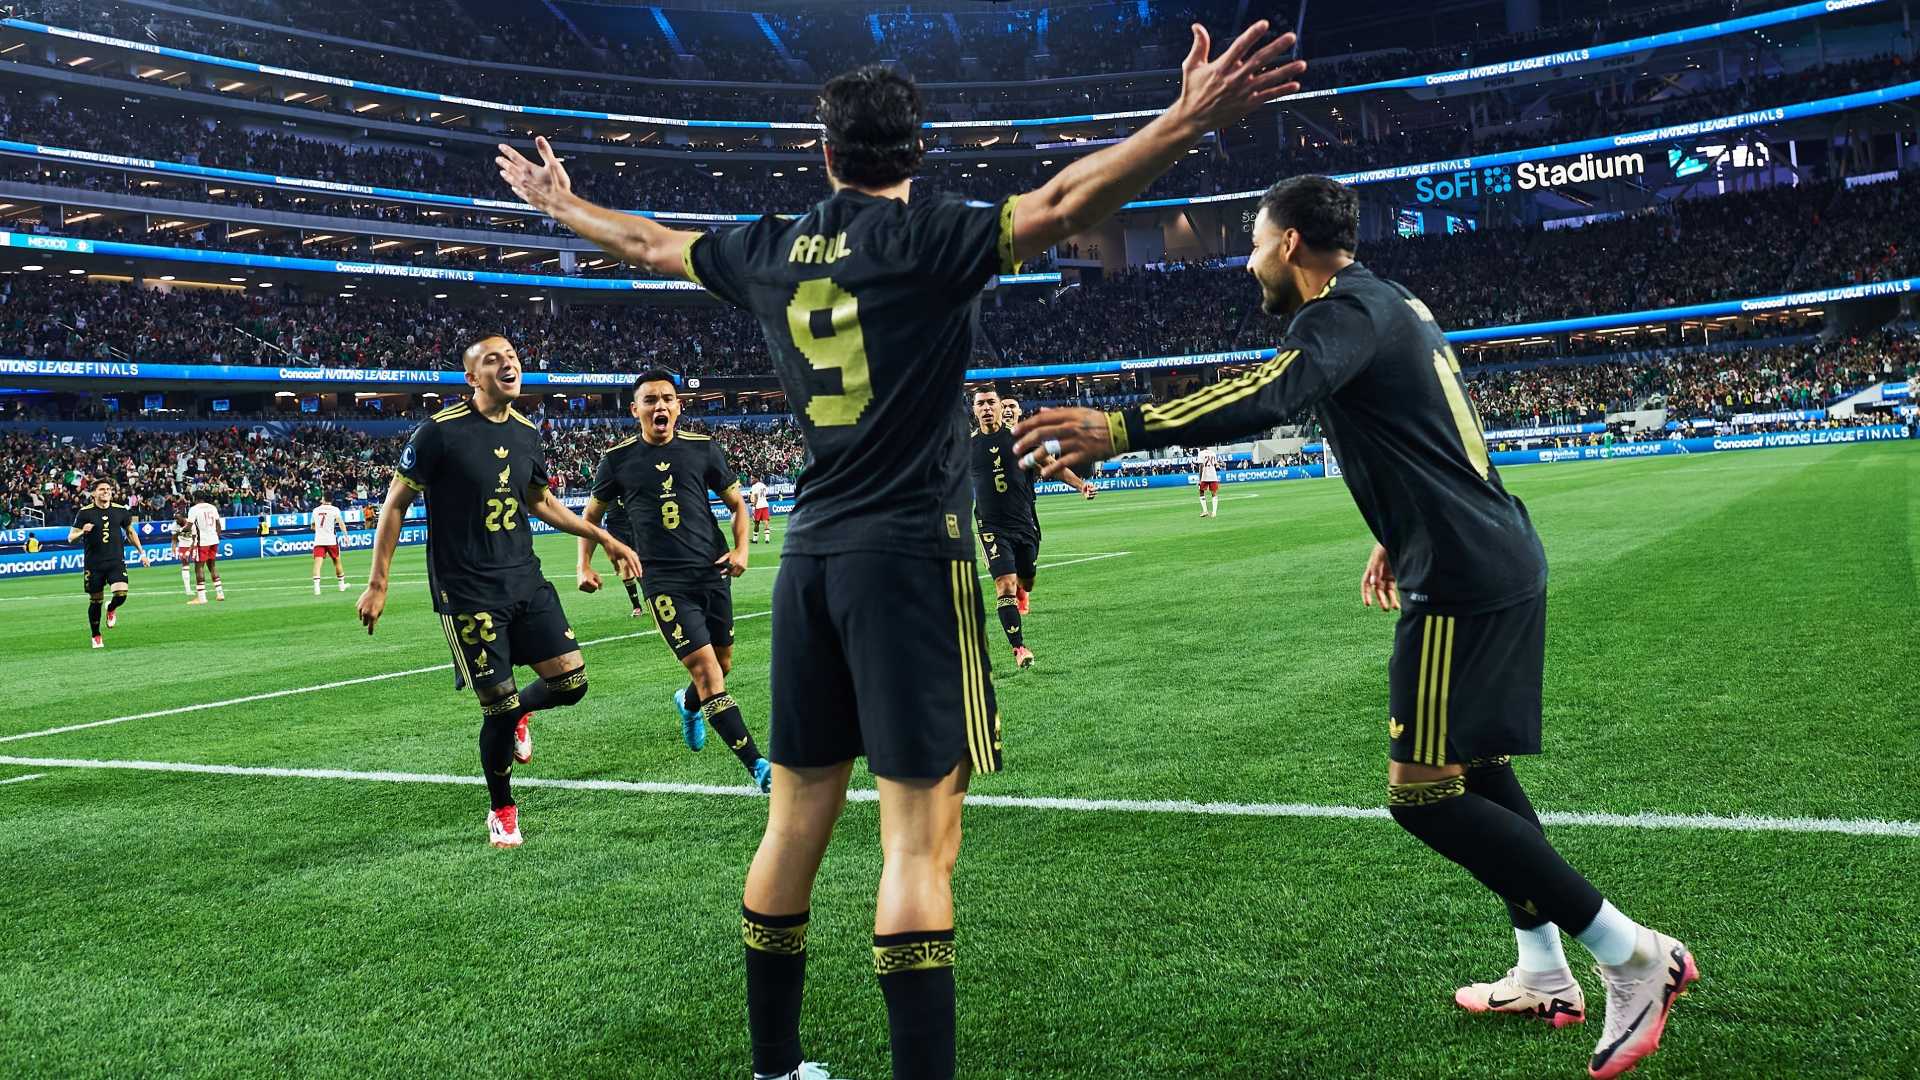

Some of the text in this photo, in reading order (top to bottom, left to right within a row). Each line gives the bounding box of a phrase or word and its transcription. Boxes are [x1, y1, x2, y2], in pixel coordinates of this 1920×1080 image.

[1426, 50, 1589, 85] Concacaf NATIONS LEAGUE FINALS
[1615, 109, 1784, 145] Concacaf NATIONS LEAGUE FINALS
[125, 157, 154, 168] FINALS
[1360, 170, 1396, 182] NATIONS
[1397, 164, 1430, 179] LEAGUE
[1431, 159, 1470, 172] FINALS
[1416, 153, 1644, 203] SoFi Stadium
[28, 237, 67, 249] MEXICO
[336, 262, 474, 281] Concacaf NATIONS LEAGUE FINALS
[632, 280, 665, 290] Concacaf
[1742, 281, 1911, 310] Concacaf NATIONS LEAGUE FINALS
[786, 277, 875, 427] 9
[1121, 351, 1262, 369] Concacaf NATIONS LEAGUE FINALS
[39, 361, 84, 374] LEAGUE
[86, 363, 138, 375] FINALS
[280, 368, 439, 382] Concacaf NATIONS LEAGUE FINALS
[548, 373, 582, 383] Concacaf
[583, 374, 614, 384] NATIONS
[1550, 424, 1582, 434] FINALS
[1714, 426, 1909, 449] Concacaf NATIONS LEAGUE FINALS
[1585, 448, 1598, 458] EN
[994, 474, 1007, 493] 6
[1110, 478, 1148, 488] FINALS
[318, 513, 327, 528] 7
[485, 497, 519, 532] 22
[661, 501, 680, 530] 8
[102, 532, 109, 543] 2
[0, 556, 57, 574] oncacaf
[655, 594, 677, 622] 8
[458, 611, 497, 645] 22
